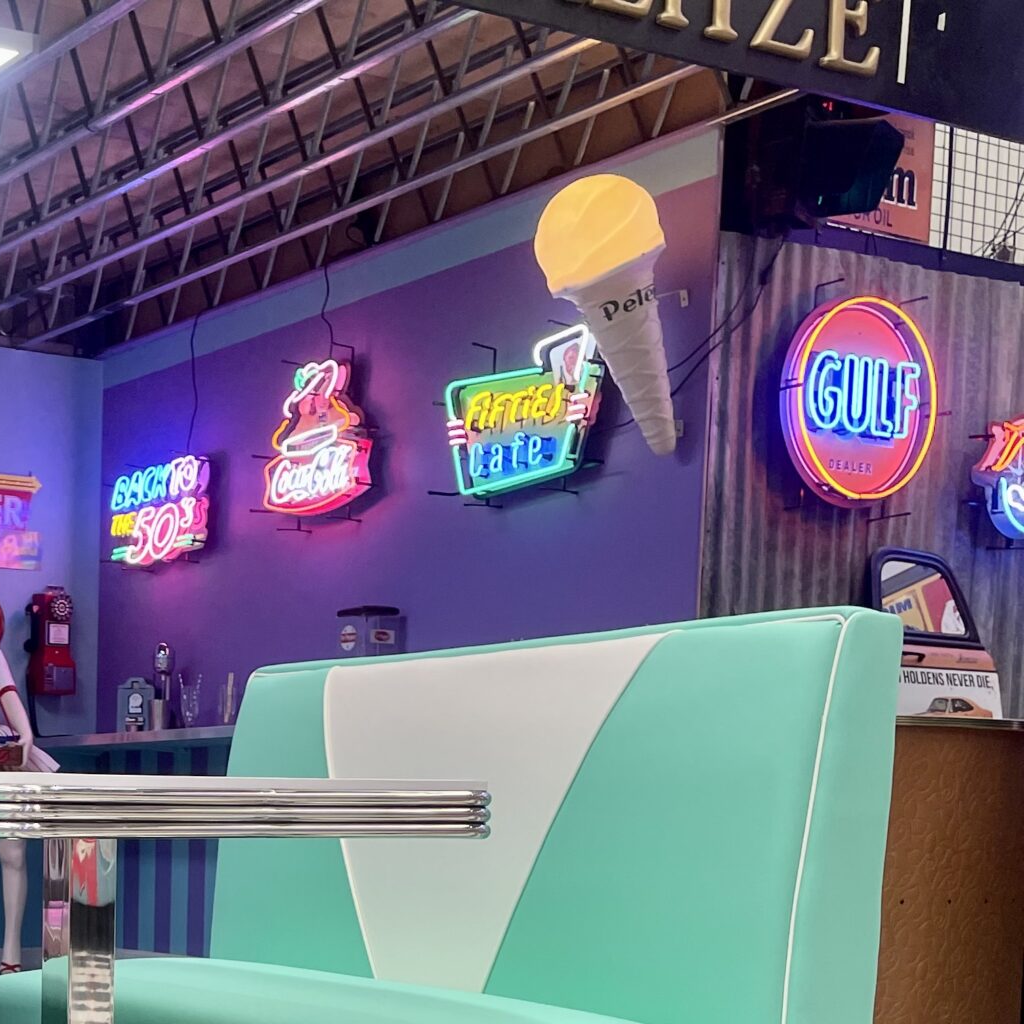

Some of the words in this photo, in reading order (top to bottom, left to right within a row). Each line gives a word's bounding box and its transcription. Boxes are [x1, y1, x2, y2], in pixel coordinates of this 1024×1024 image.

[598, 283, 656, 322] Pete
[808, 349, 921, 439] GULF
[469, 431, 543, 477] Cafe
[828, 458, 873, 475] DEALER
[111, 463, 174, 511] BACK
[168, 455, 198, 495] TO
[110, 512, 137, 537] THE
[902, 670, 945, 686] HOLDENS
[945, 673, 975, 687] NEVER
